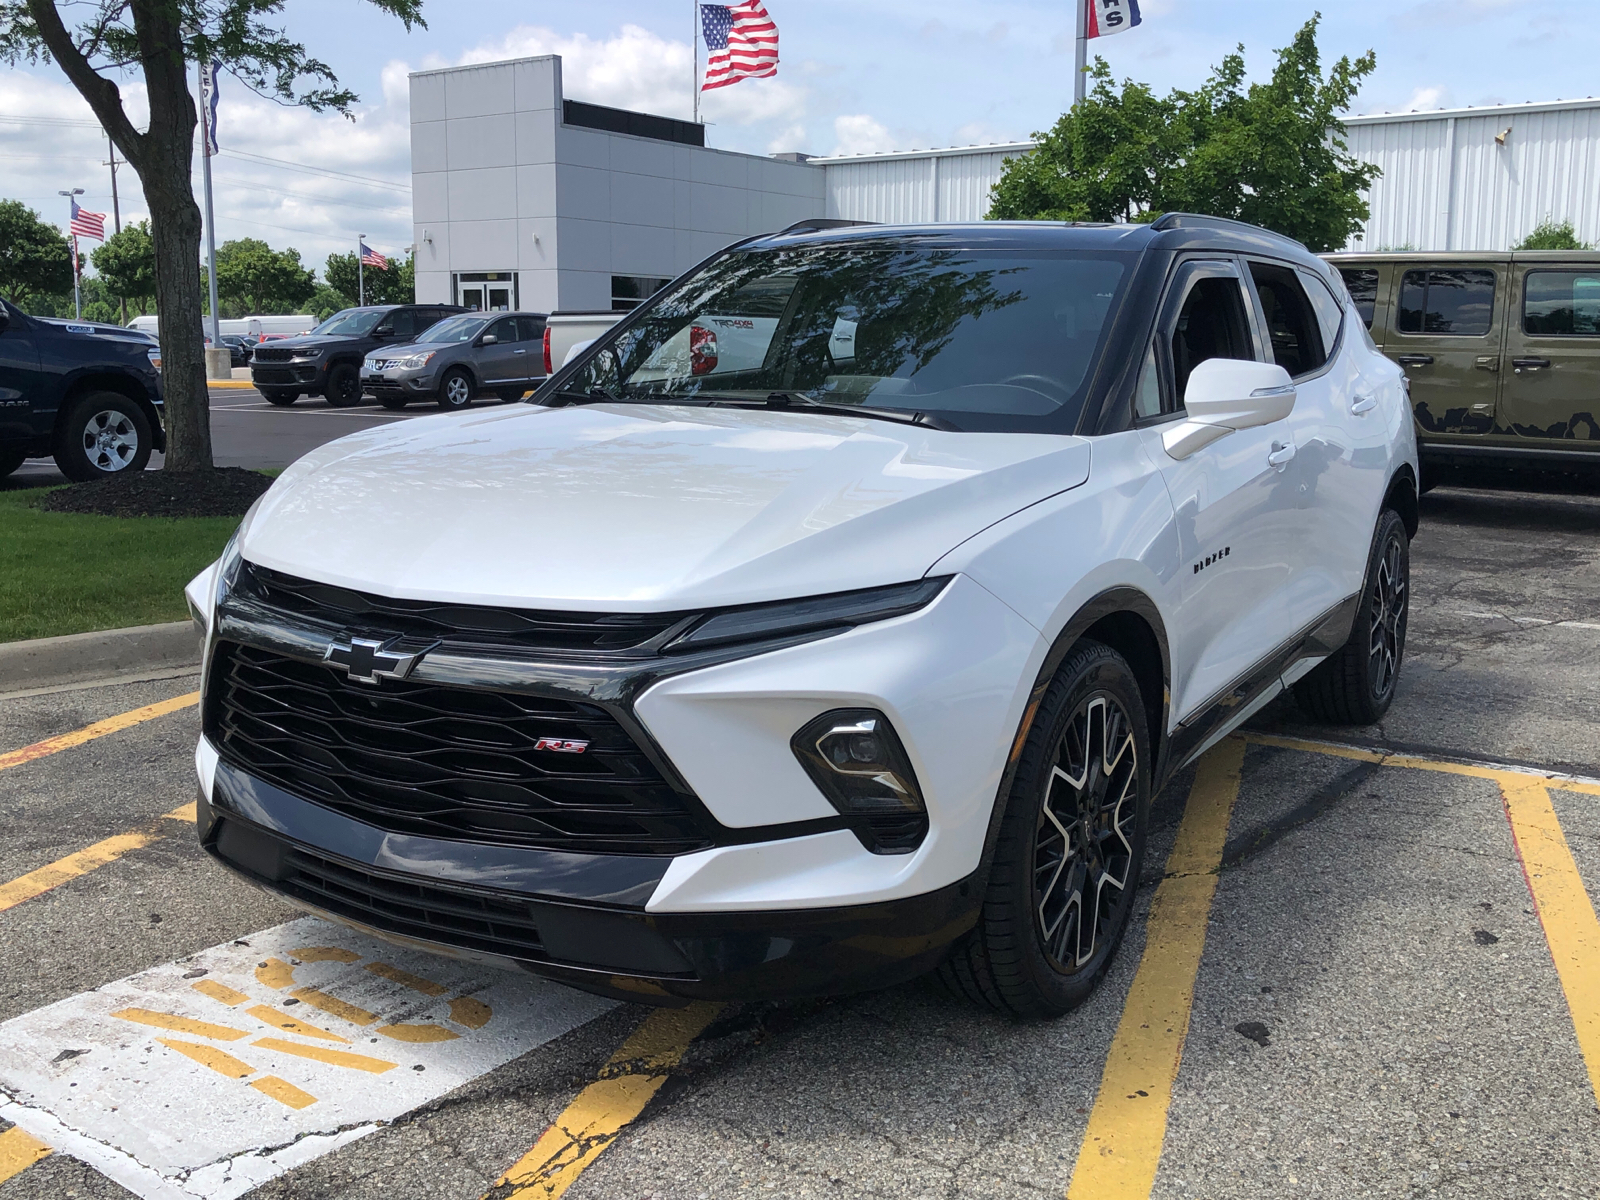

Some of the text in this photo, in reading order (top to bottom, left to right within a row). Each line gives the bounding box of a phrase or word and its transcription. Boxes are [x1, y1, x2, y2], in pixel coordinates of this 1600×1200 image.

[1193, 546, 1231, 575] BLAZER
[533, 737, 590, 754] RS
[111, 946, 493, 1109] NO
